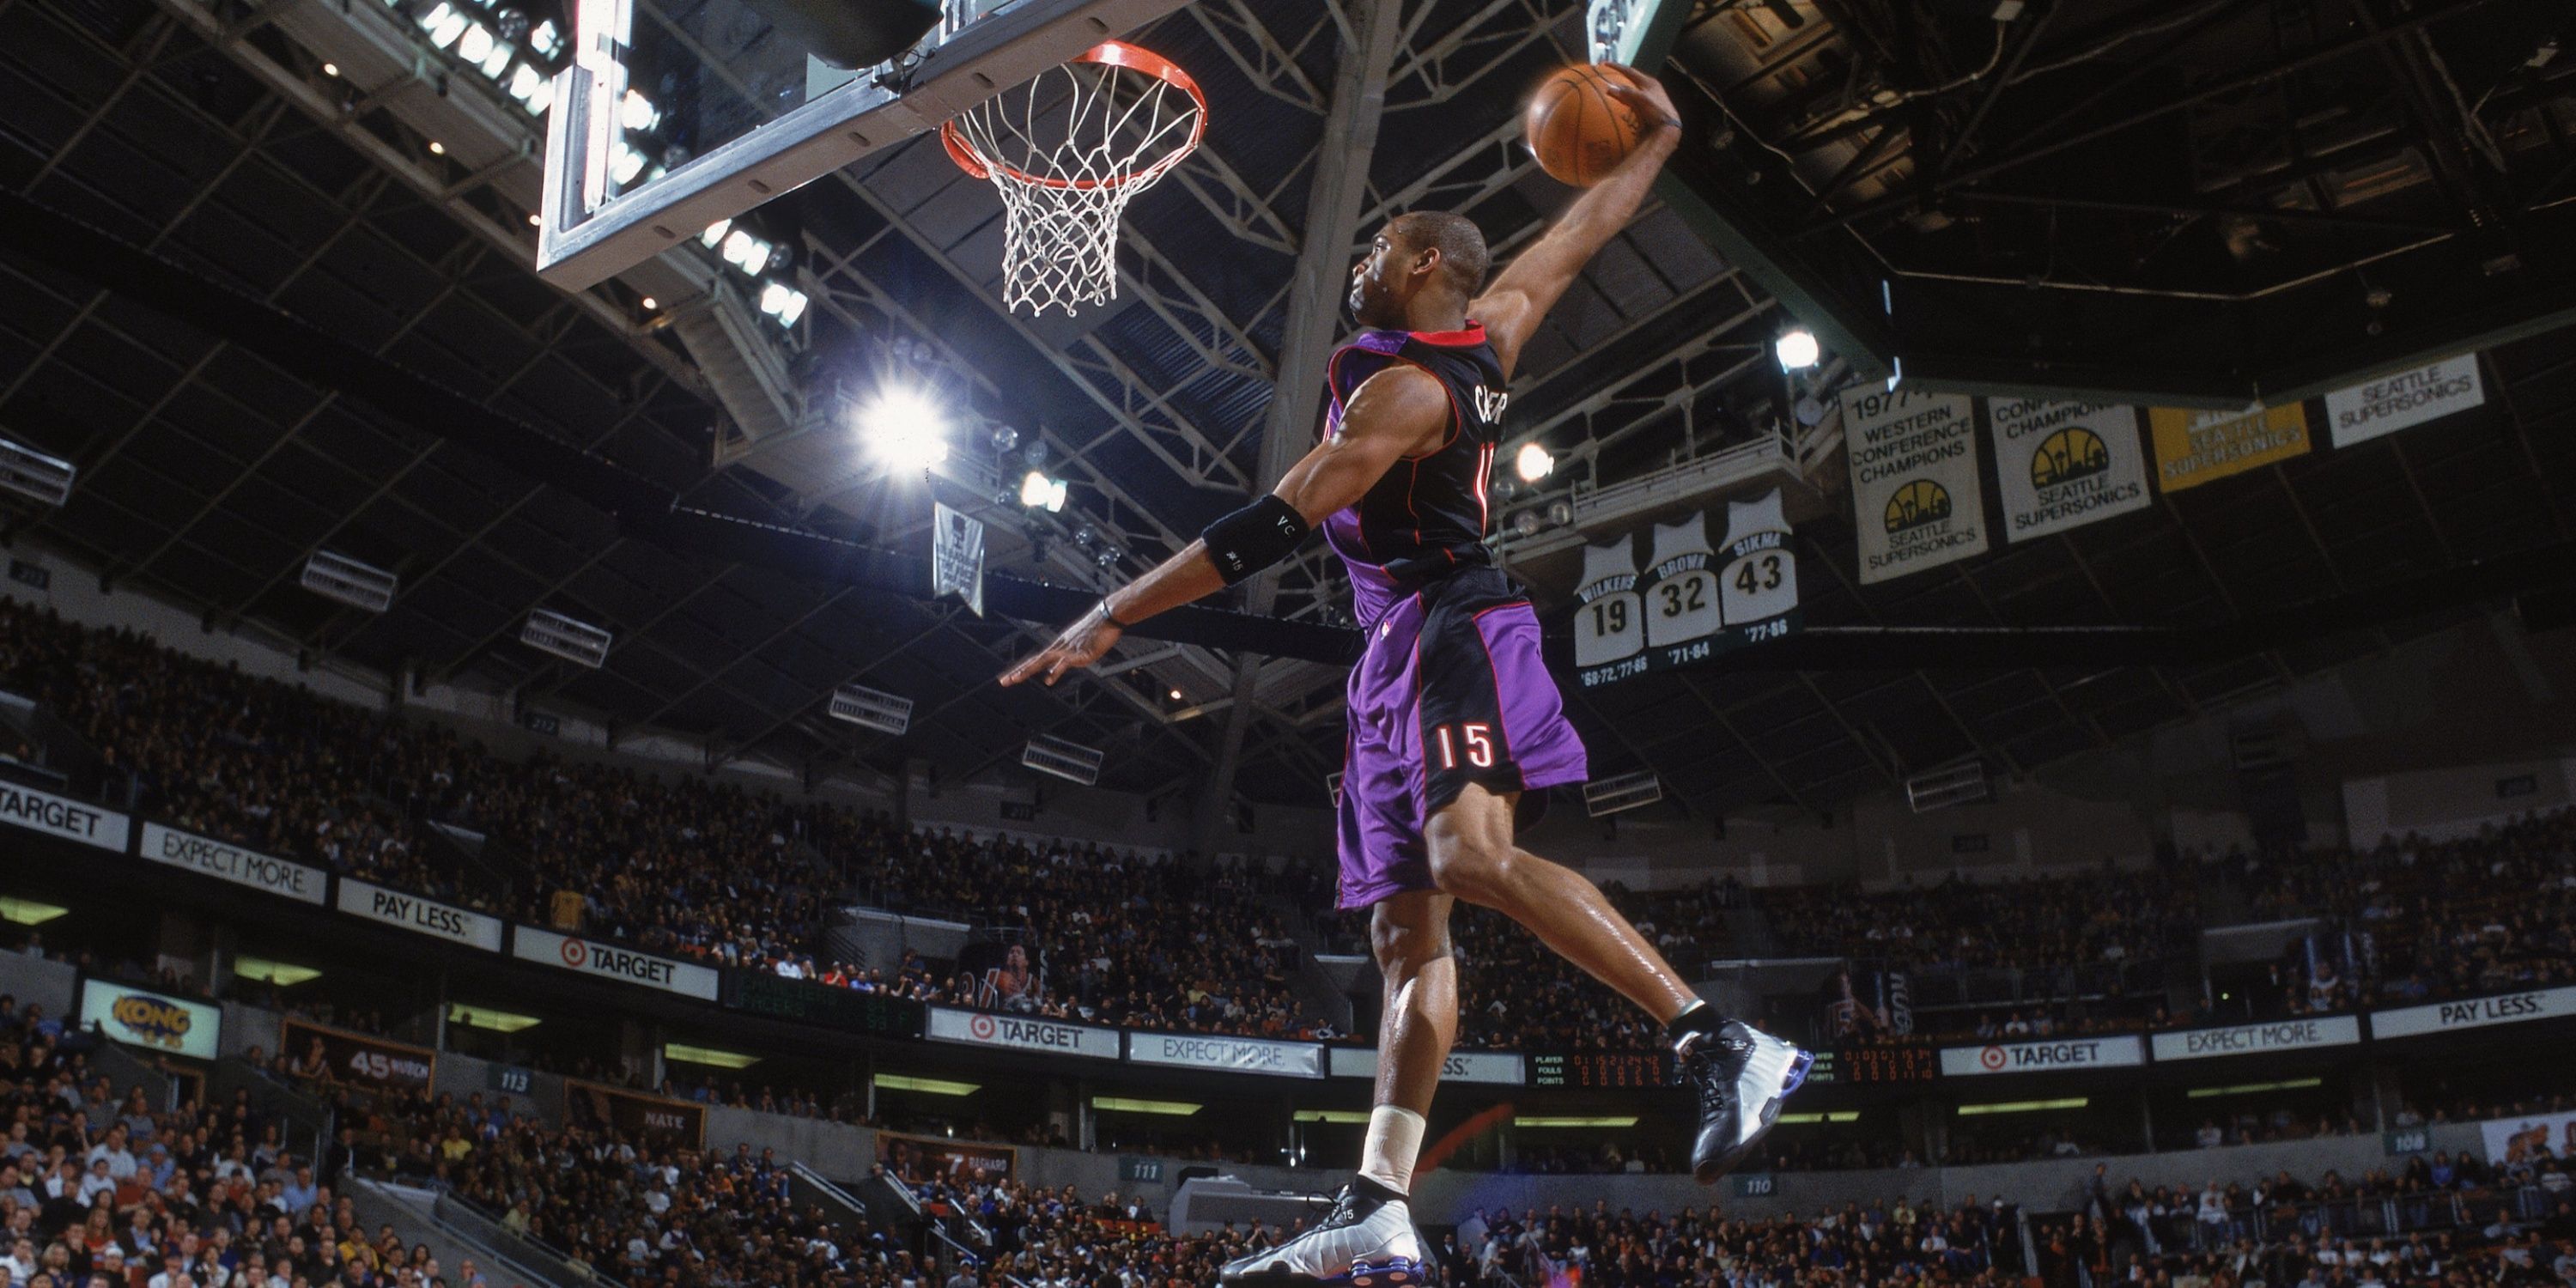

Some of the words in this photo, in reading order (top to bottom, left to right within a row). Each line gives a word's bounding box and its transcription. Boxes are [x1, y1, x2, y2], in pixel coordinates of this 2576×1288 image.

[2362, 367, 2441, 404] SEATTLE
[2340, 374, 2472, 430] SUPERSONICS
[1865, 405, 1952, 444] WESTERN
[1851, 416, 1972, 466] CONFERENCE
[1860, 440, 1965, 483] CHAMPIONS
[2015, 481, 2141, 530] SUPERSONICS
[2038, 474, 2109, 507] SEATTLE
[1733, 532, 1781, 557] SIKMA
[1868, 527, 1978, 569] SUPERSONICS
[1890, 520, 1952, 550] SEATTLE
[1656, 552, 1707, 580] BROWN
[1736, 556, 1782, 595] 43
[1578, 573, 1637, 604] WILKENS
[1662, 576, 1705, 618] 32
[1593, 598, 1627, 637] 19
[1668, 641, 1710, 665] '71-84
[1437, 721, 1496, 770] 15
[163, 831, 238, 874] EXPECT
[374, 891, 410, 920] PAY
[416, 900, 465, 936] LESS.
[590, 946, 676, 985] TARGET
[112, 995, 191, 1035] KONG
[2440, 1002, 2478, 1025] PAY
[999, 1019, 1084, 1048] TARGET
[2188, 1027, 2255, 1053] EXPECT
[350, 1050, 390, 1079] 45
[1163, 1038, 1228, 1063] EXPECT
[1534, 1055, 1564, 1065] PLAYER
[2010, 1042, 2100, 1066] TARGET
[501, 1072, 528, 1093] 113
[945, 1152, 964, 1176] 7
[1133, 1163, 1157, 1180] 111
[1747, 1179, 1771, 1194] 110
[1342, 1208, 1354, 1220] 15
